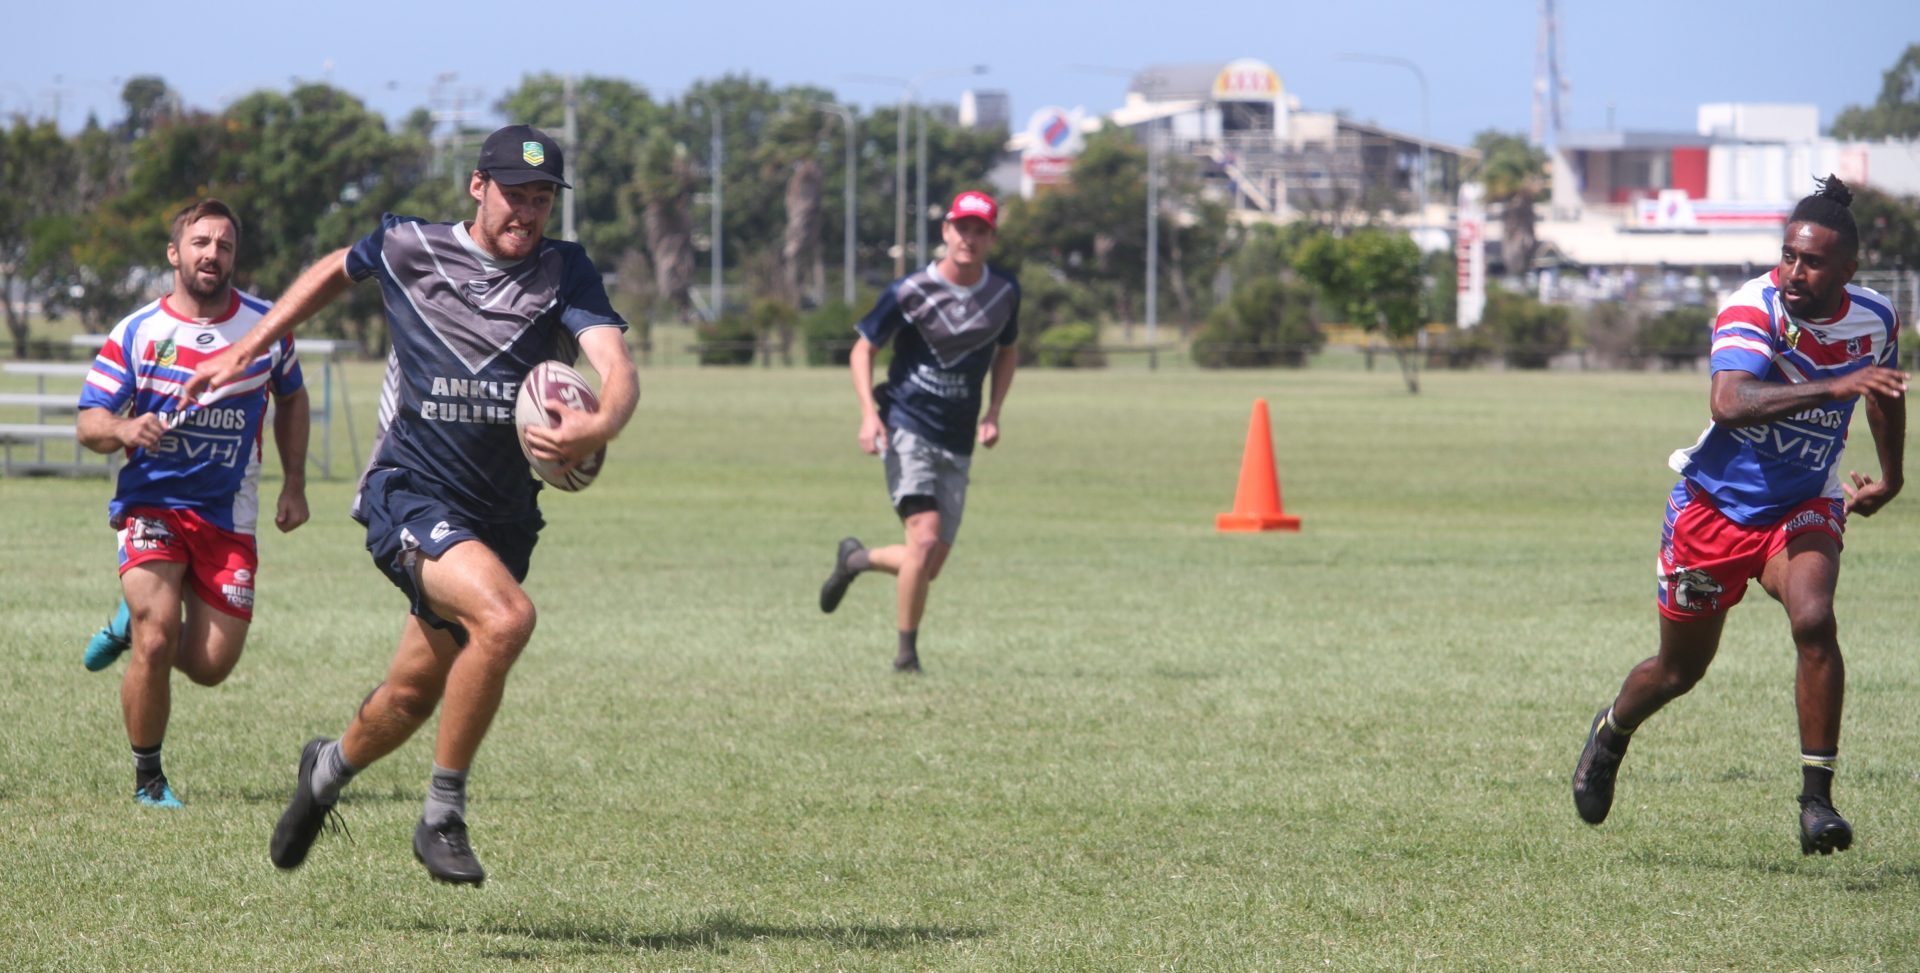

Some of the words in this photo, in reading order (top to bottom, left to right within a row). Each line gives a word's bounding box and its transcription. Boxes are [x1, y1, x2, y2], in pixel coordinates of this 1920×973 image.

[431, 377, 517, 400] ANKLE
[157, 435, 234, 460] BVH
[1736, 424, 1826, 462] BVH
